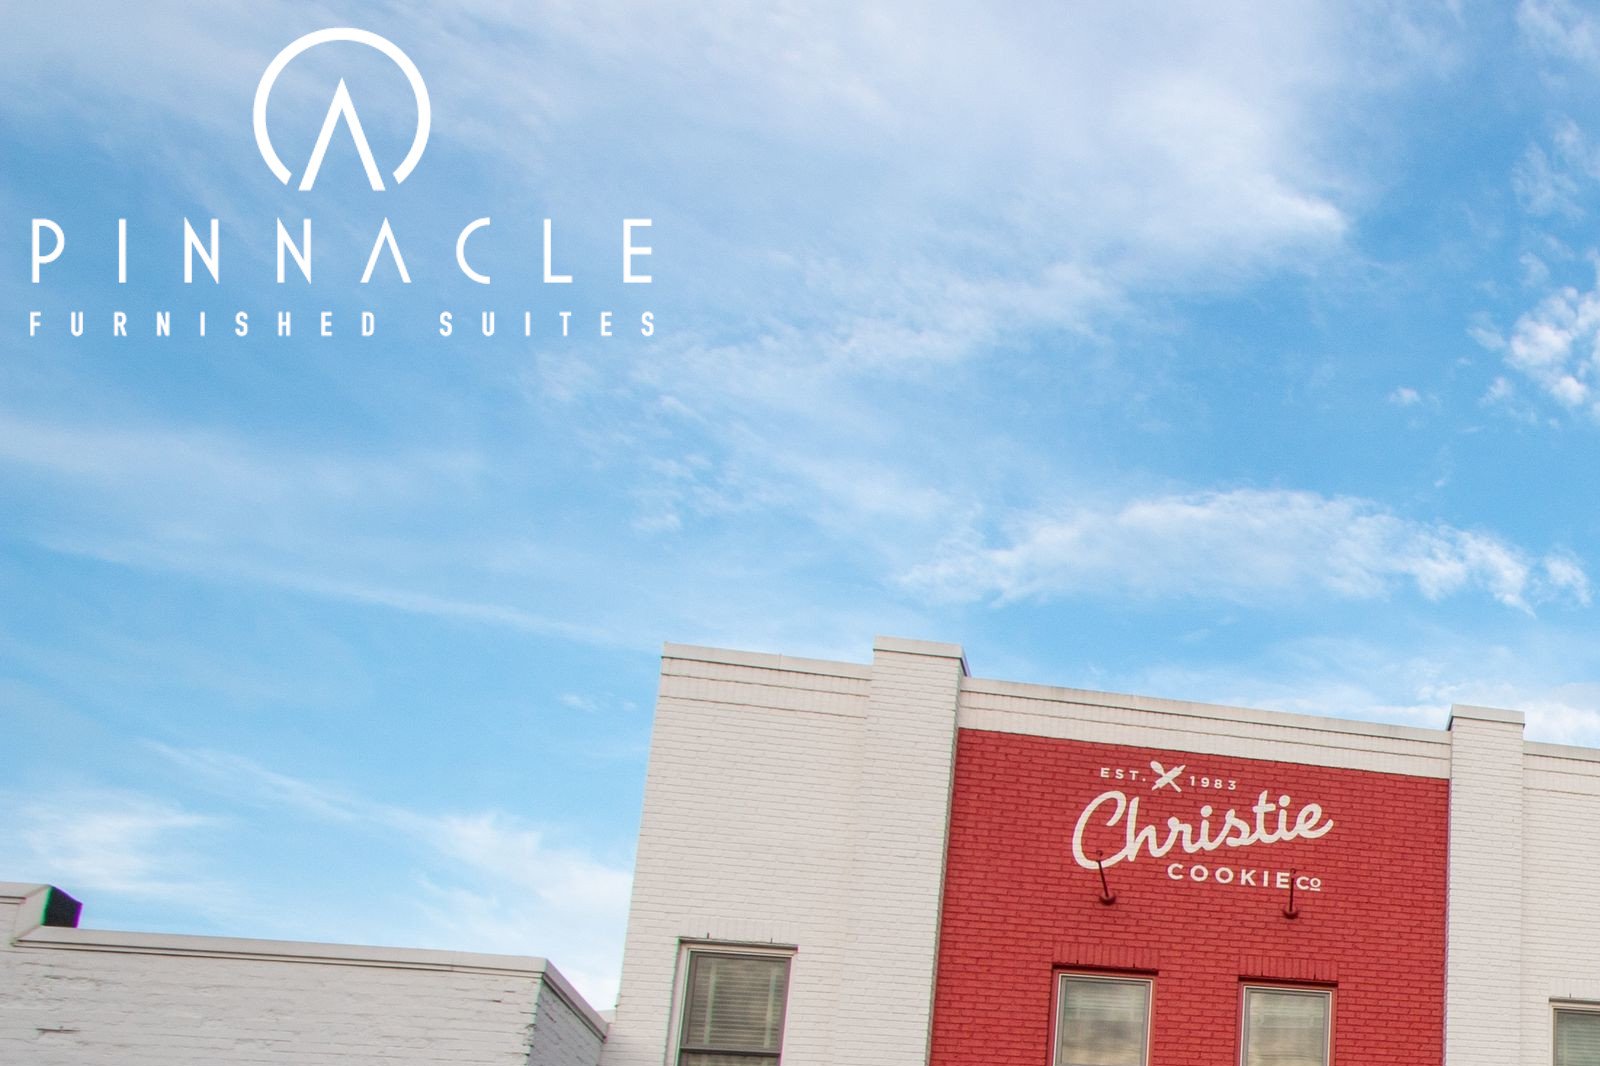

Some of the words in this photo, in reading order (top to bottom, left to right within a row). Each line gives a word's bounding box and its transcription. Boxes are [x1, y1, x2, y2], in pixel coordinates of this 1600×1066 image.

[1100, 767, 1147, 782] EST.
[1189, 776, 1237, 790] 1983
[1072, 790, 1334, 870] Christie
[1167, 863, 1291, 890] COOKIE
